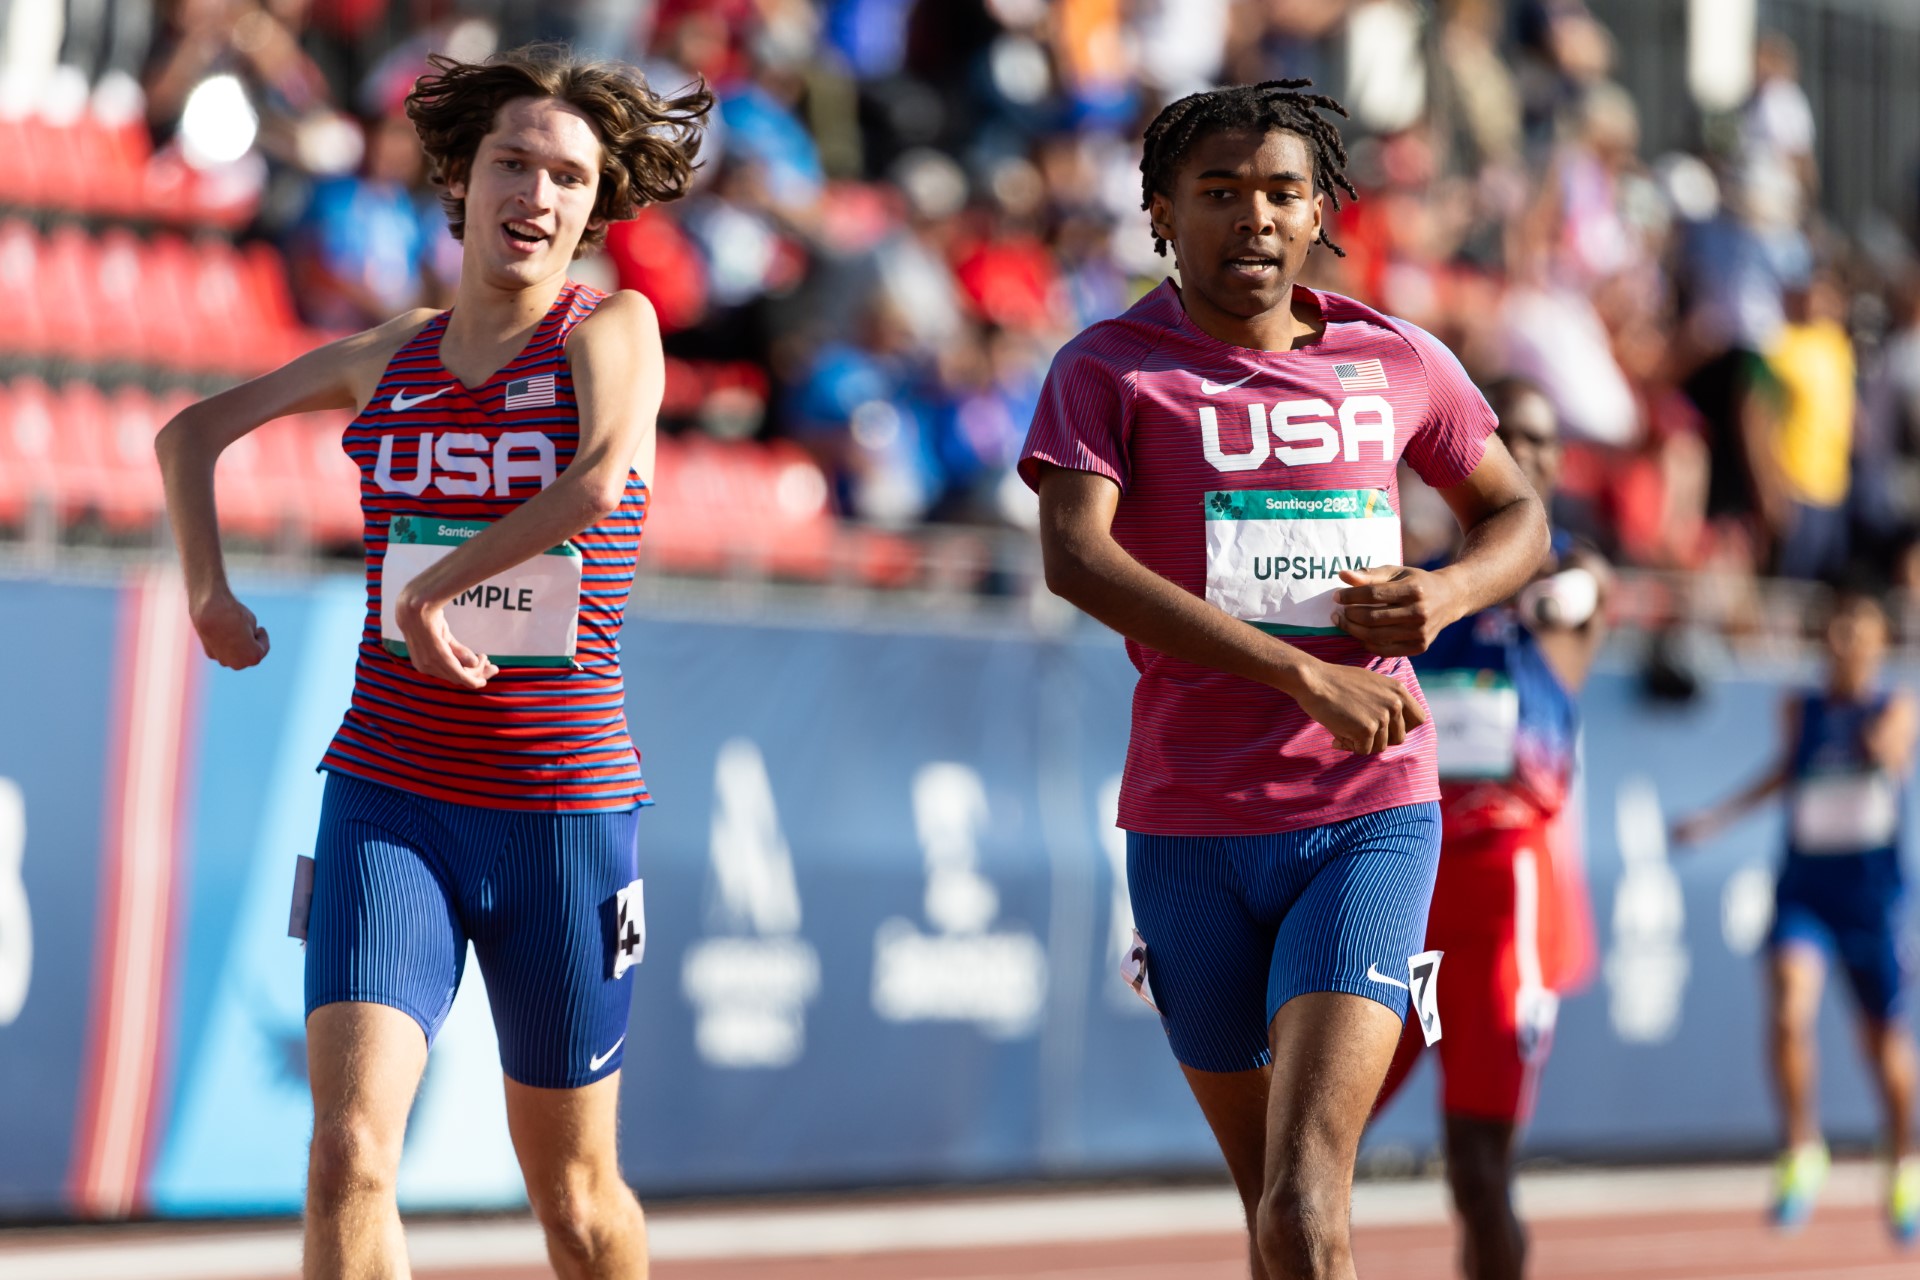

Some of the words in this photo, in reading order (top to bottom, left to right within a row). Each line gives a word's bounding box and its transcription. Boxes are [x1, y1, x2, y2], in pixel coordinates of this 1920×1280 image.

[374, 431, 557, 497] USA
[1199, 395, 1396, 472] USA
[618, 899, 640, 956] 4
[1413, 962, 1434, 1033] 7
